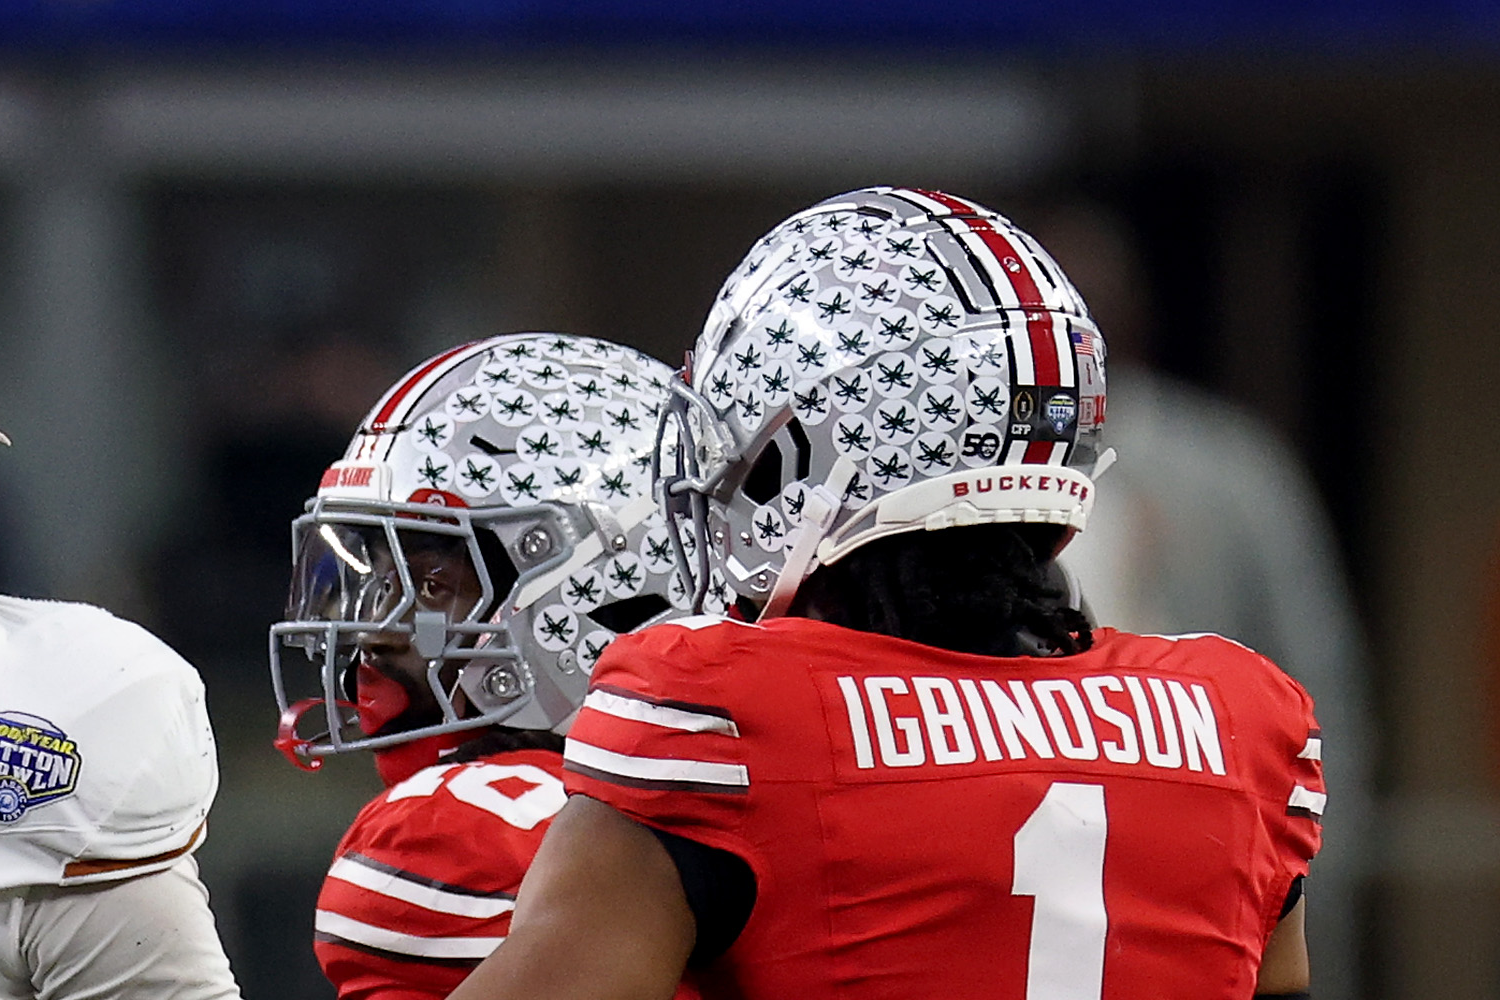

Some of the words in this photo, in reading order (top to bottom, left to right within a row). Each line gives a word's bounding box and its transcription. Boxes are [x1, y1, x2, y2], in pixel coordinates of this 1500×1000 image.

[1011, 424, 1031, 435] CFP
[953, 475, 1088, 501] BUCKEYES
[837, 675, 1226, 776] IGBINOSUN
